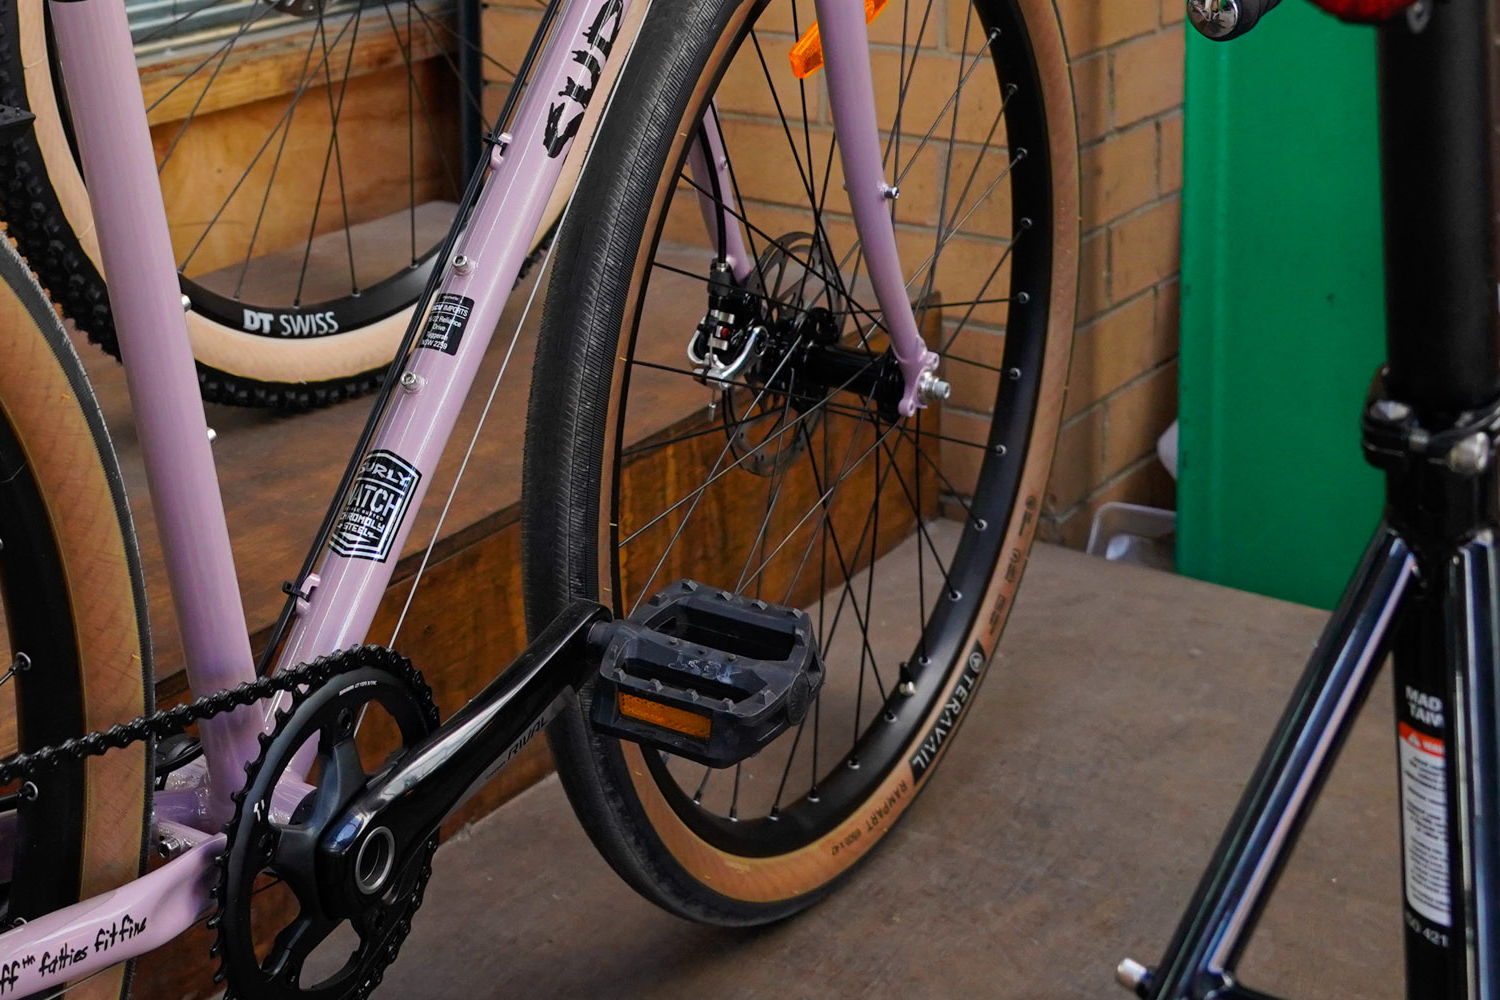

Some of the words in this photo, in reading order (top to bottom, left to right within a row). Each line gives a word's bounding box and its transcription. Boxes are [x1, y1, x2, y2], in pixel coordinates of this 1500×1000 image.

[243, 308, 275, 334] DT
[279, 311, 339, 336] SWISS
[443, 304, 469, 317] IMPORTS
[432, 323, 446, 331] Drive
[360, 461, 412, 487] SURLY
[912, 673, 976, 769] TERAVAIL
[508, 716, 548, 761] RIVAL
[38, 942, 88, 978] fatties
